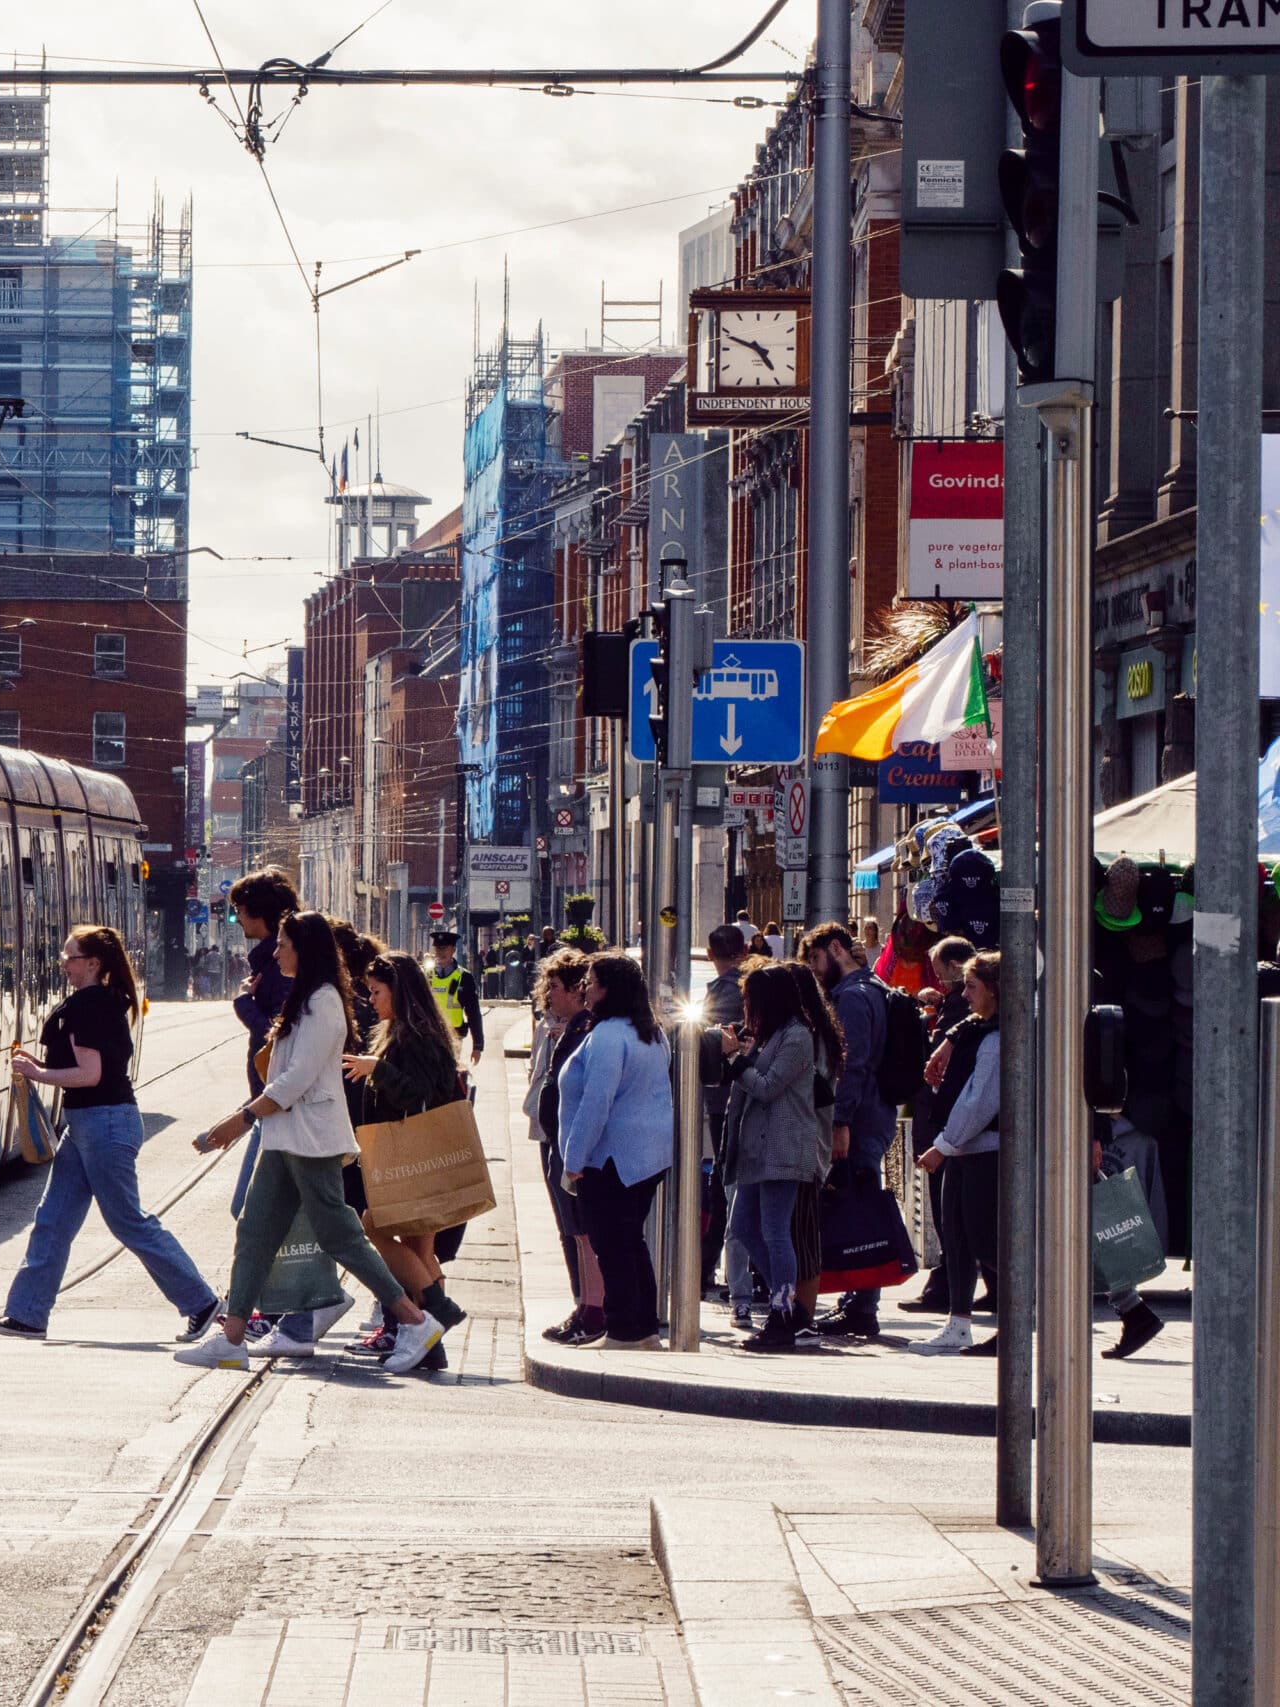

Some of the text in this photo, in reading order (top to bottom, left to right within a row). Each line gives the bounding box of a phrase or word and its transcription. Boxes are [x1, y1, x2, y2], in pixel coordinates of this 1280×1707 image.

[698, 398, 811, 410] INDEPENDENT HOUS
[928, 542, 954, 554] pure
[934, 558, 1005, 571] & plant-bas
[954, 743, 988, 751] ISKCO
[471, 853, 529, 863] AINSCAFF
[384, 1147, 473, 1181] STRADIVARIUS
[1095, 1215, 1144, 1243] PULL&BEAR
[276, 1241, 324, 1257] LL&BEA
[842, 1239, 889, 1255] SKECHERS
